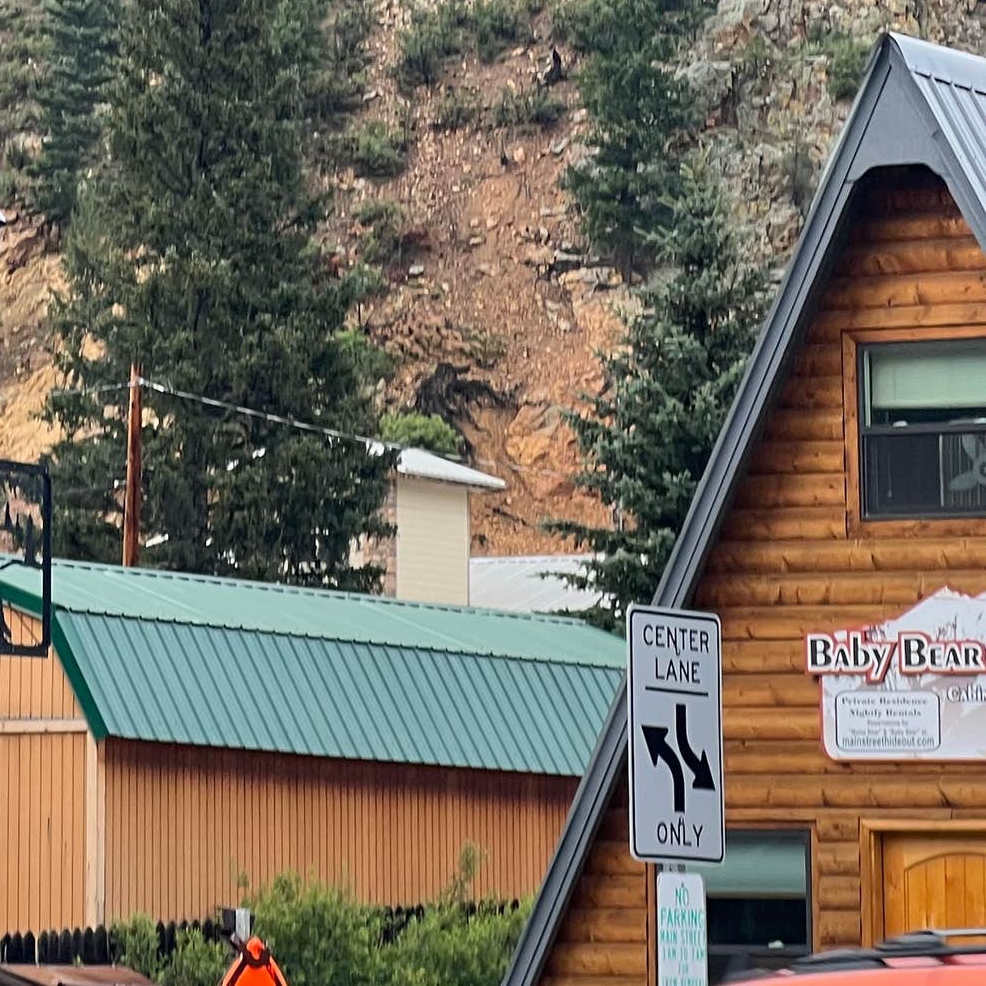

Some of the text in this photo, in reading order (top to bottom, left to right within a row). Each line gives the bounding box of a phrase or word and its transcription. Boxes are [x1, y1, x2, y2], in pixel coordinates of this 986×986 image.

[643, 624, 709, 653] CENTER
[808, 635, 982, 678] Baby BEAR
[655, 657, 701, 684] LANE
[841, 697, 927, 705] Private Residence
[850, 709, 922, 718] Nightly Rentals
[657, 821, 703, 847] ONLY
[675, 887, 690, 907] NO
[660, 908, 705, 928] PARKING
[660, 929, 678, 945] MAIN
